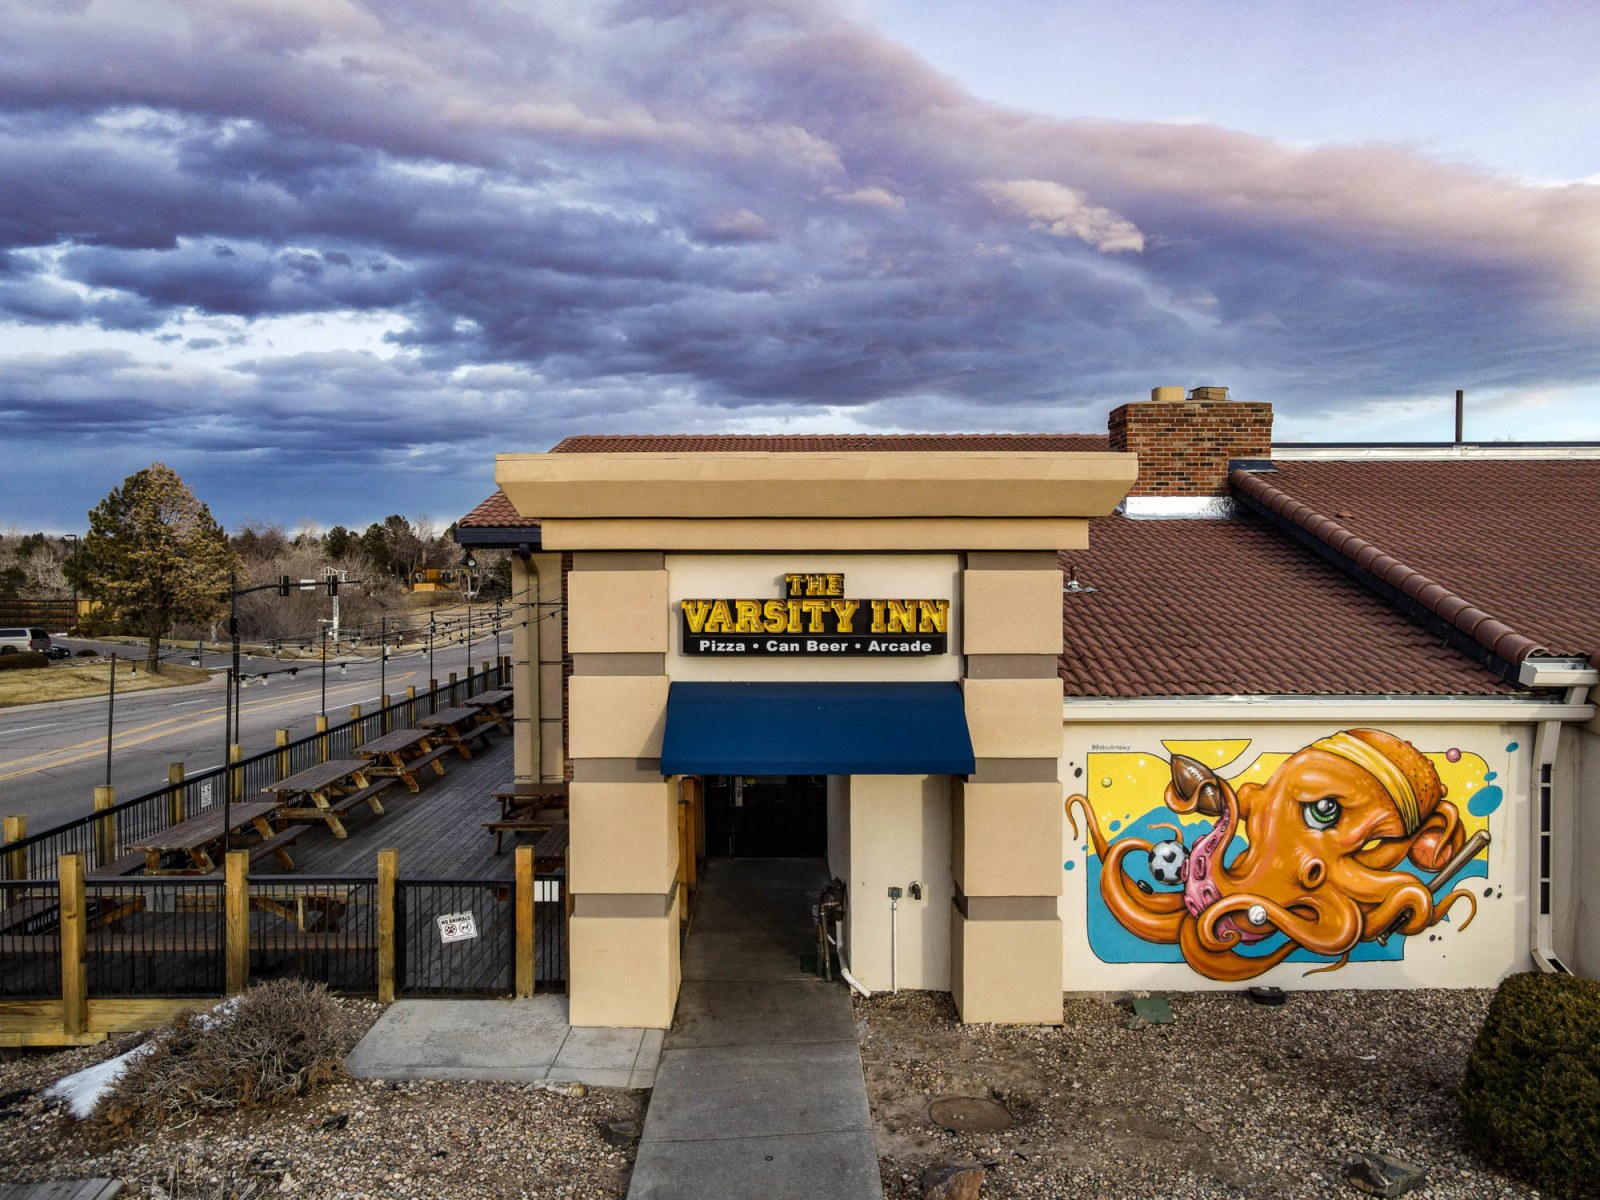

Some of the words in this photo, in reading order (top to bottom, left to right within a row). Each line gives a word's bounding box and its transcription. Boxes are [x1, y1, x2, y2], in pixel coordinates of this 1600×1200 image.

[786, 574, 845, 596] THE
[681, 599, 860, 633] VARSITY
[871, 599, 950, 633] INN
[699, 640, 746, 652] Pizza
[766, 640, 800, 652] Can
[806, 640, 849, 652] Beer
[868, 640, 932, 652] Arcade
[449, 915, 471, 923] ANIMALS
